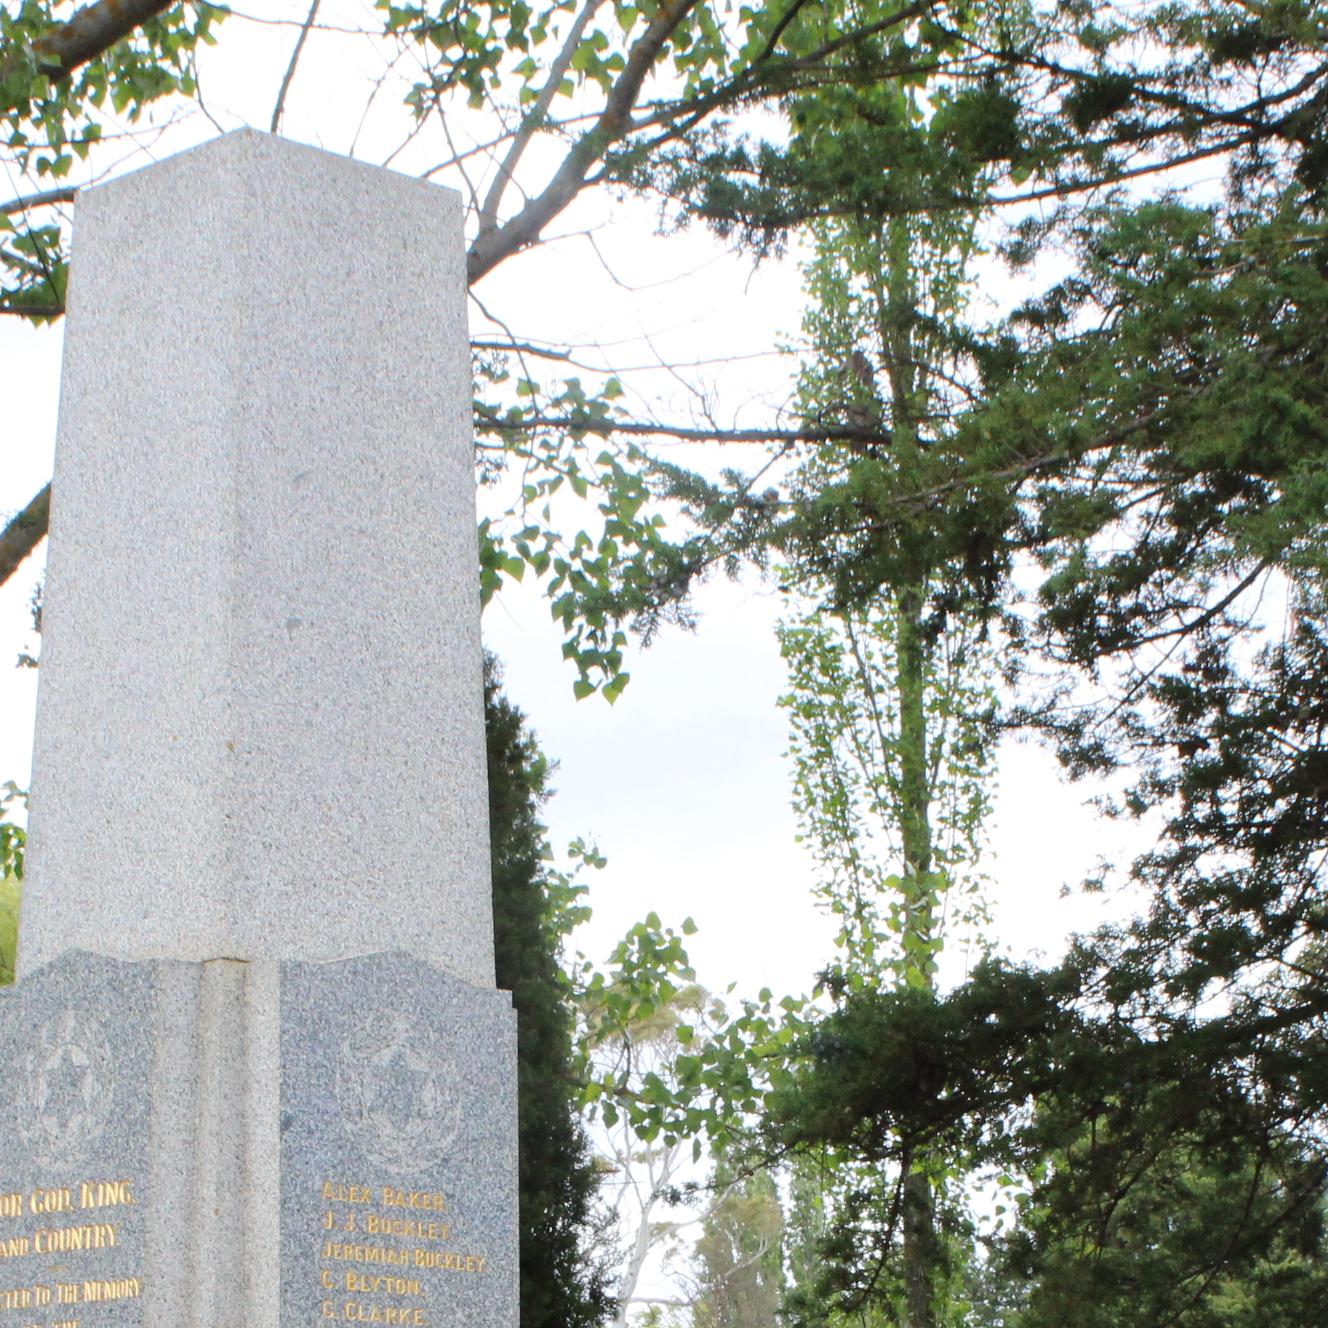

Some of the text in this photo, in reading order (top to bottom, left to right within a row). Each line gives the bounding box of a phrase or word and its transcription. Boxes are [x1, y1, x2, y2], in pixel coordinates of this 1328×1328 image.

[322, 1179, 371, 1204] ALEX
[322, 1240, 409, 1266] JEREMIAH
[34, 1284, 51, 1306] TO
[56, 1282, 81, 1304] THE
[83, 1277, 143, 1302] MEMORY
